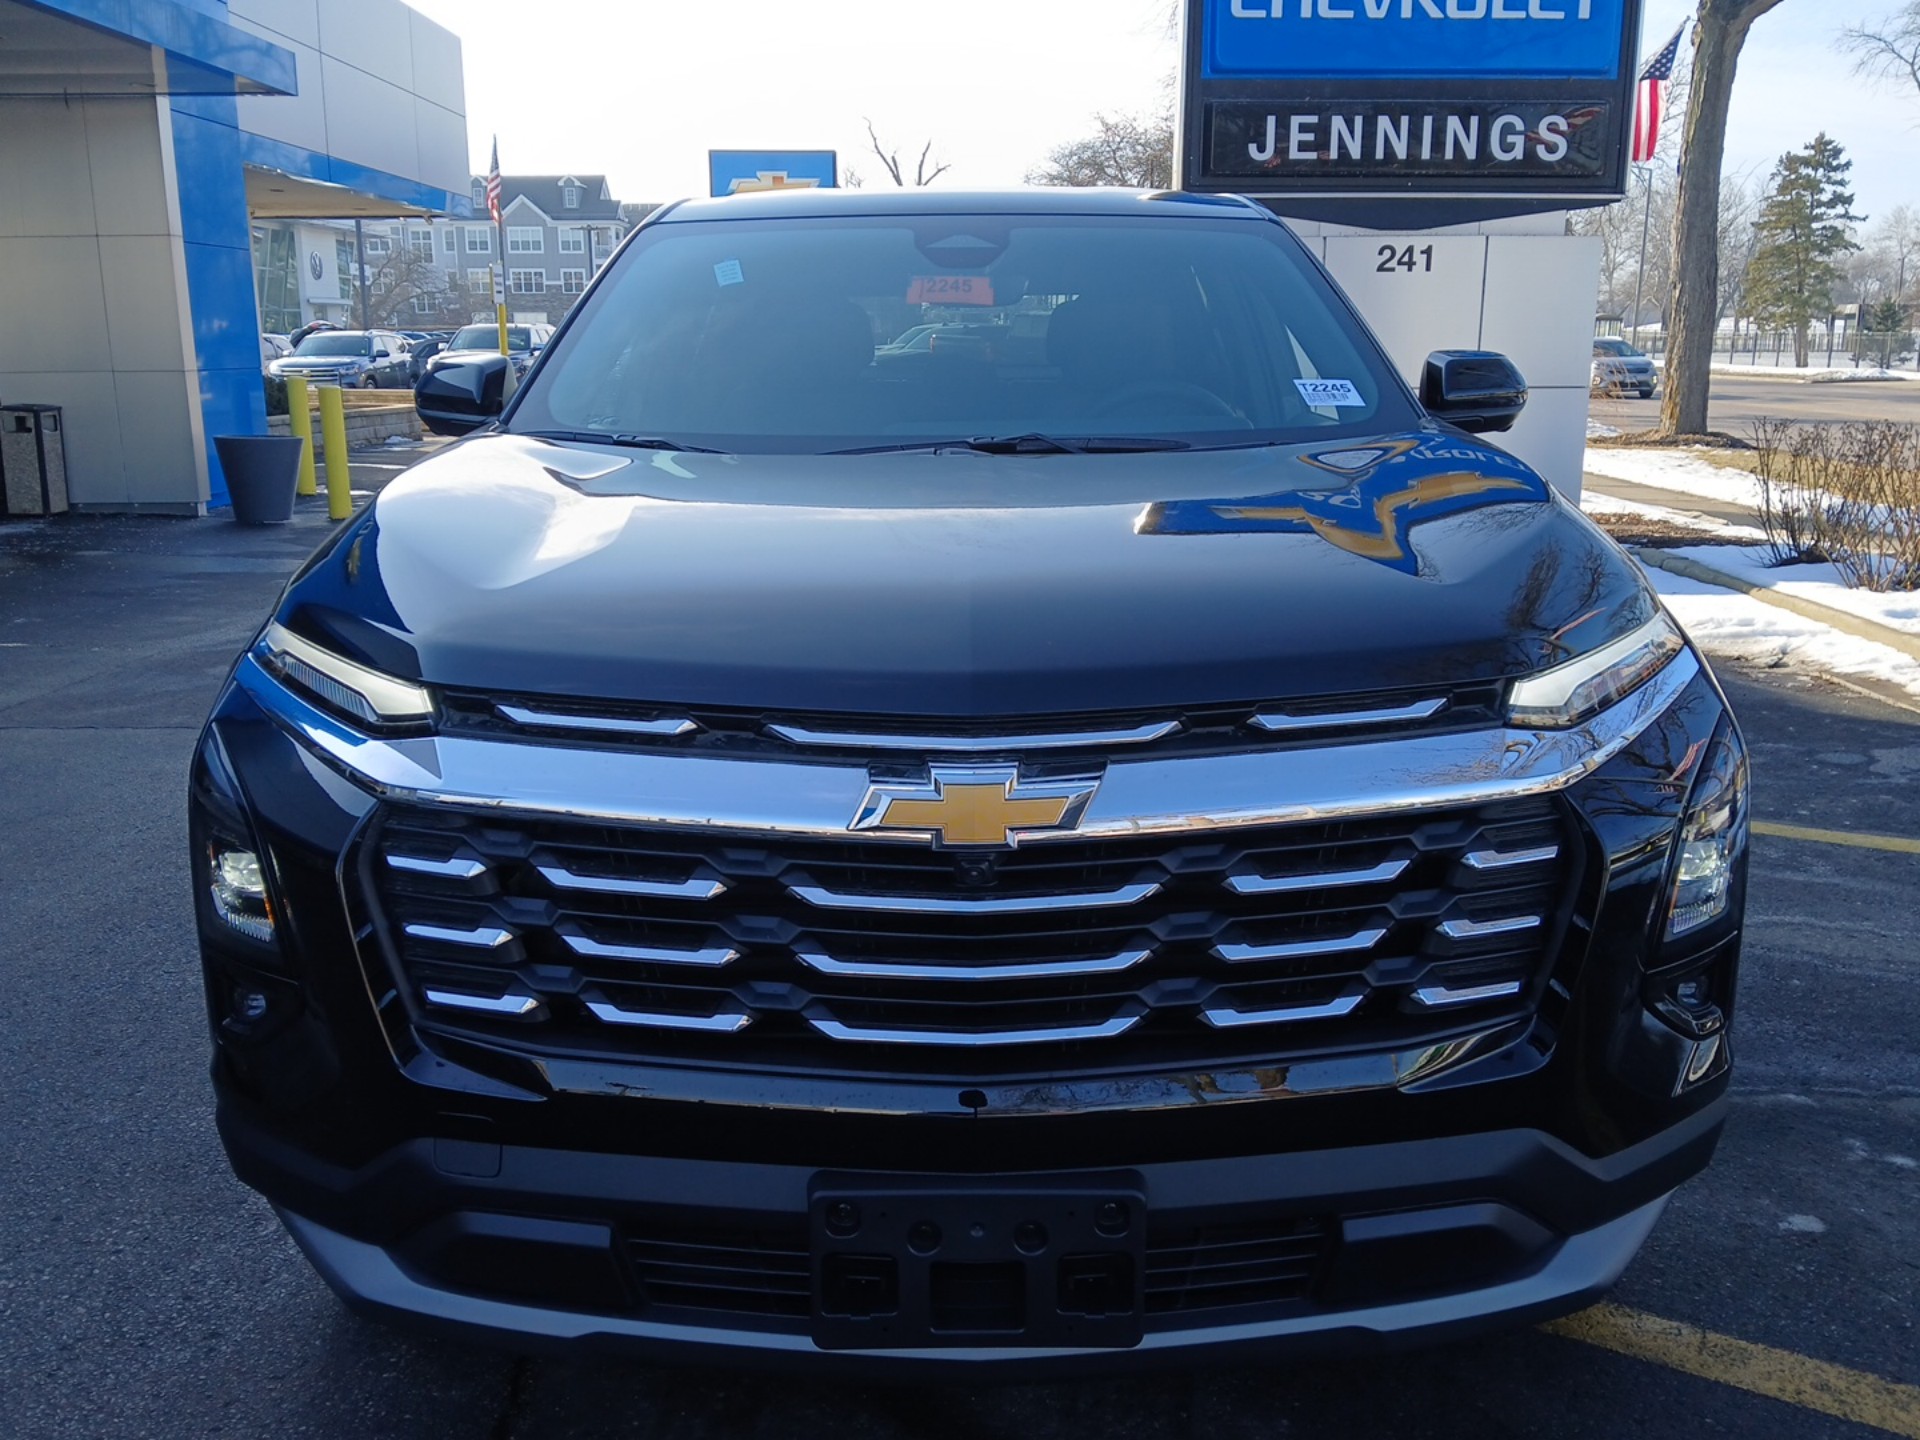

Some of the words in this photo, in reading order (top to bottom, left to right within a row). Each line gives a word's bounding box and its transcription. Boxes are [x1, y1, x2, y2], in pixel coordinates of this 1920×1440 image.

[1248, 114, 1570, 162] JENNINGS
[1376, 244, 1433, 272] 241
[1298, 383, 1351, 393] T2245
